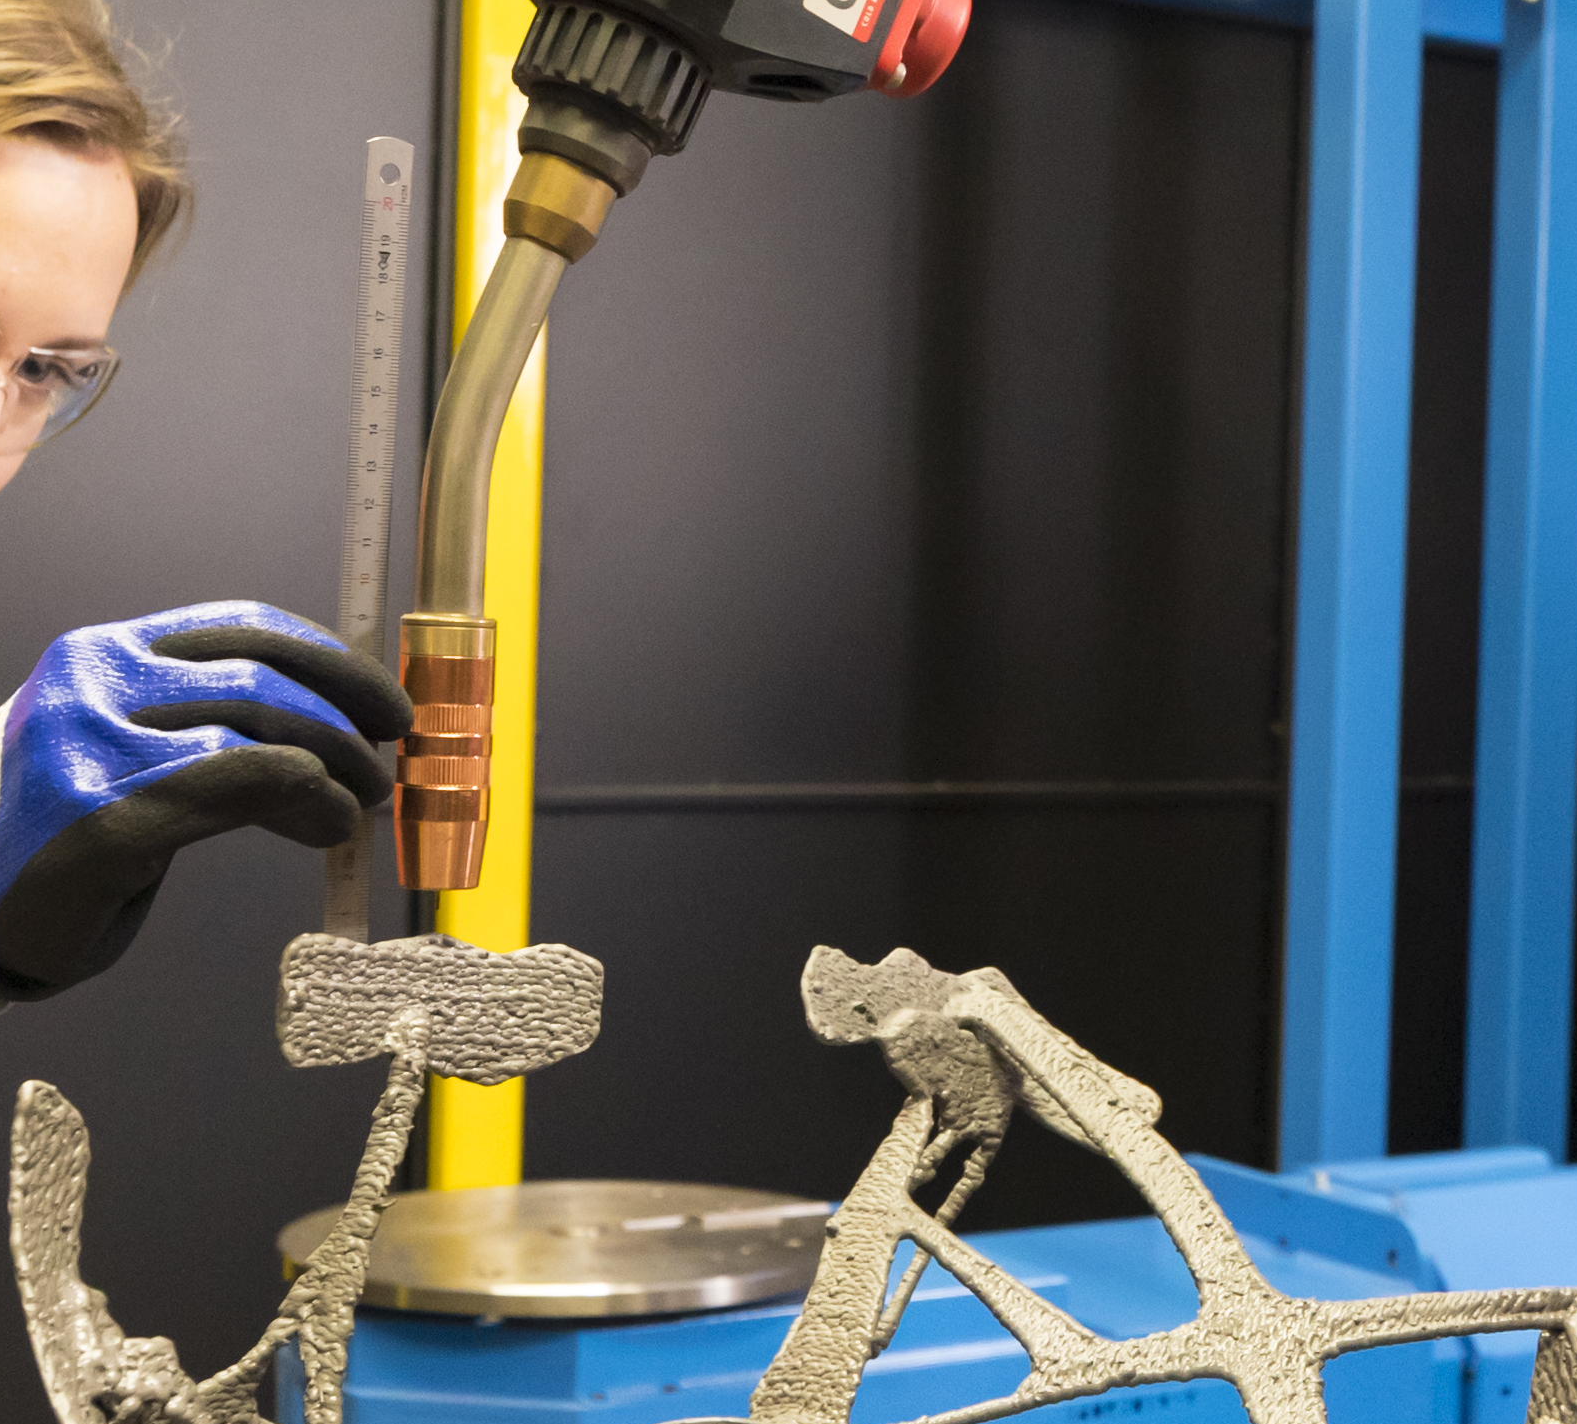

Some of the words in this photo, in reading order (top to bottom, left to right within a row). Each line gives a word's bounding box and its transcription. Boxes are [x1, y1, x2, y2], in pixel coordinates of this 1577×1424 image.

[861, 4, 875, 27] COLD
[383, 196, 394, 211] 20
[380, 234, 391, 247] 19
[378, 272, 389, 285] 18
[375, 310, 385, 322] 17
[373, 347, 383, 360] 16
[371, 385, 381, 397] 15
[369, 423, 378, 435] 14
[366, 460, 377, 472] 13
[364, 498, 374, 511] 12
[362, 537, 372, 548] 11
[360, 572, 370, 586] 10
[357, 613, 368, 621] 9
